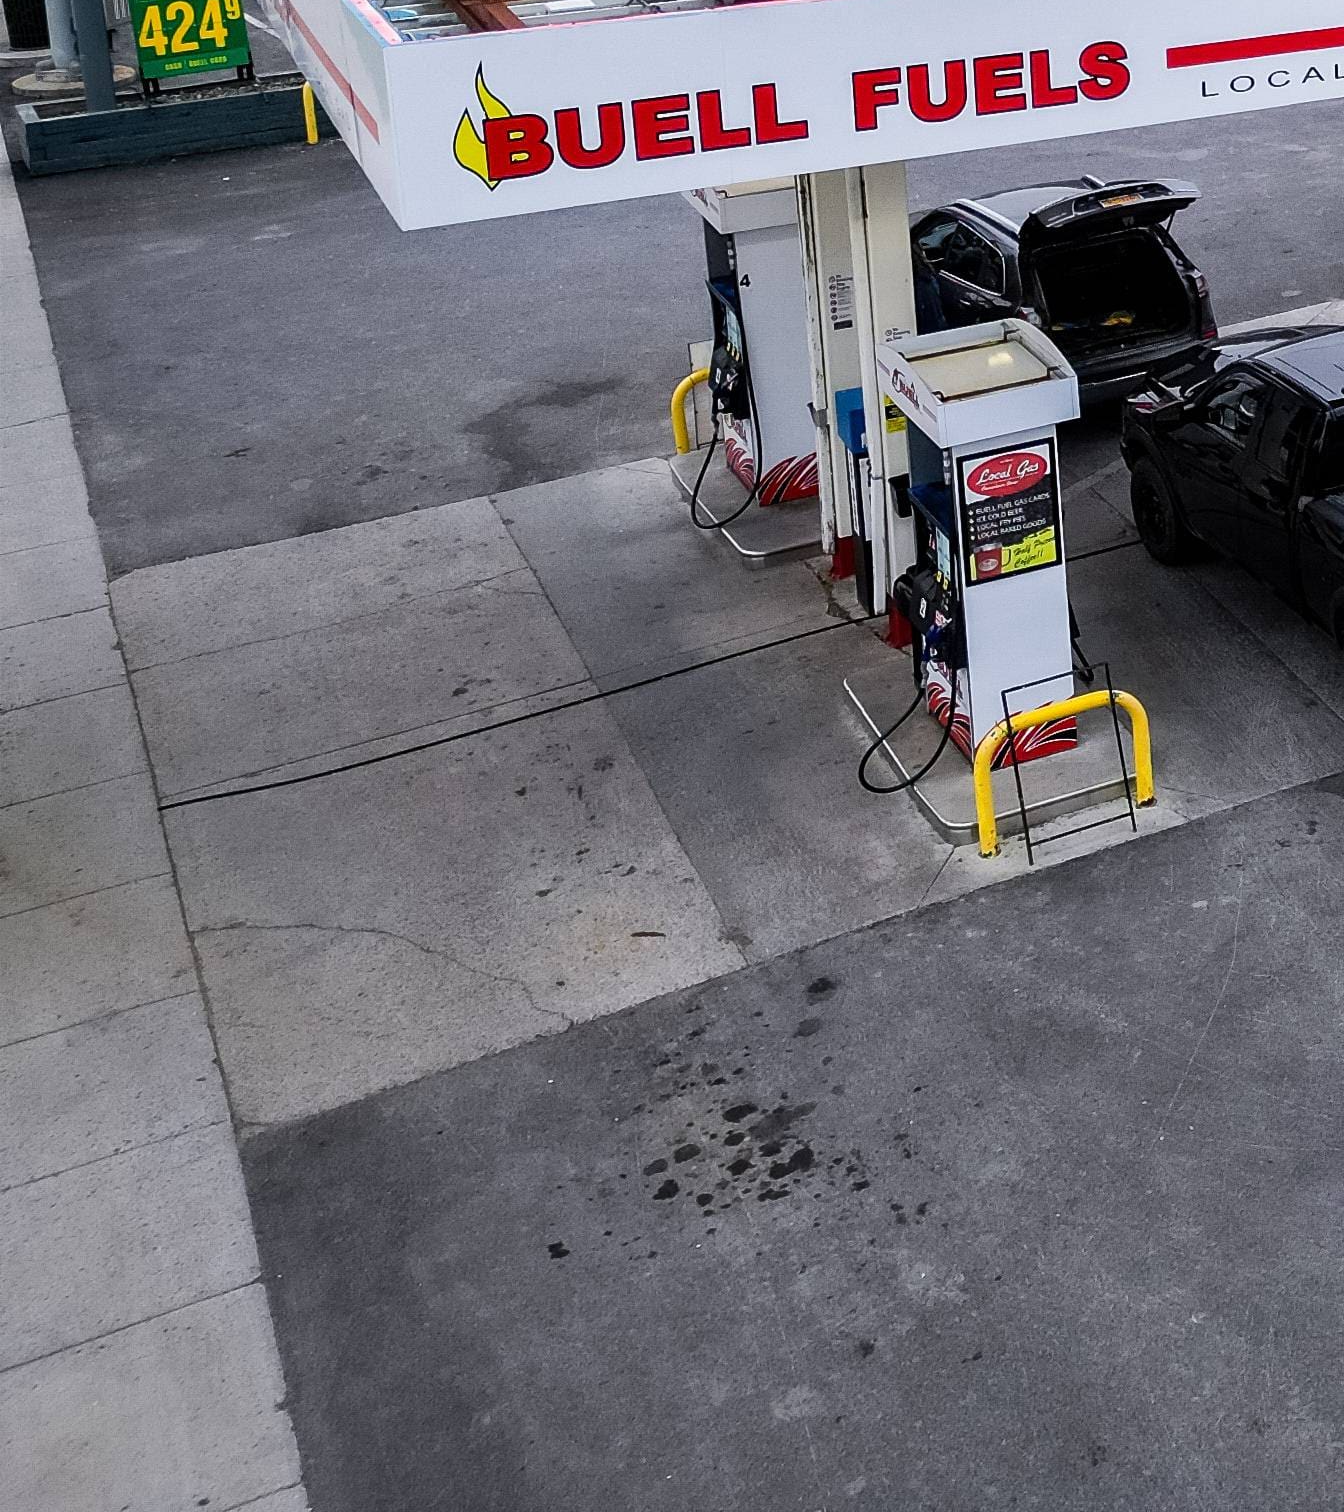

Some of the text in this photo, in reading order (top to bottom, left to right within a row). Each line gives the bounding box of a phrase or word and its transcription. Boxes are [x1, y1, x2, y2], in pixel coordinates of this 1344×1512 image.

[482, 40, 1131, 182] BUELL FUELS
[739, 273, 751, 288] 4
[975, 463, 1013, 486] Local
[1016, 459, 1040, 479] Gas
